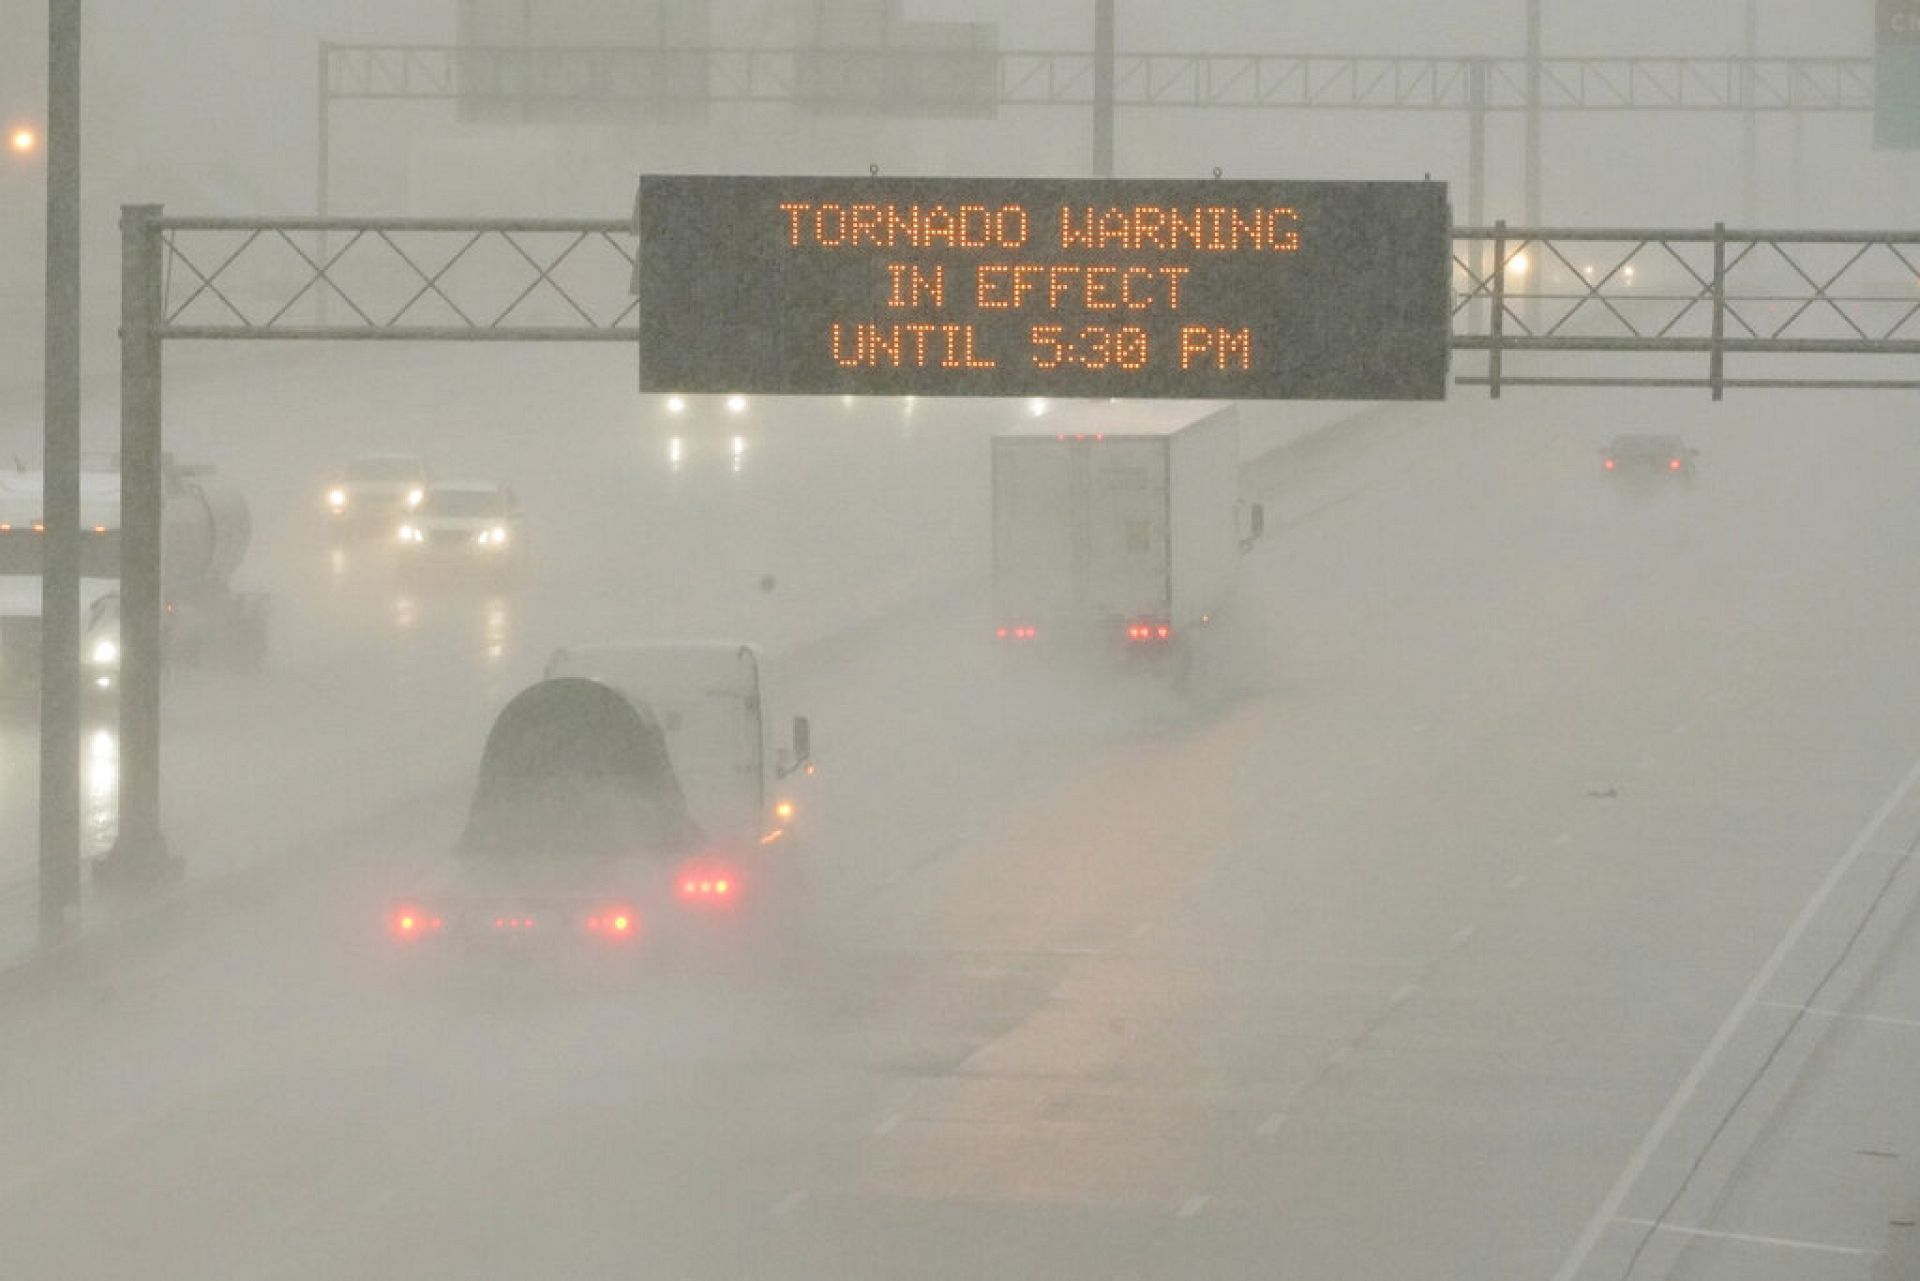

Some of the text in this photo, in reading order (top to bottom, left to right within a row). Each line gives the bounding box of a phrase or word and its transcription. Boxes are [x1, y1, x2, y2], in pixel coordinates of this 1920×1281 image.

[779, 202, 1300, 252] TORNADO WARNING
[886, 262, 1190, 311] IN EFFECT
[830, 322, 1252, 372] UNTIL 5:30 PM
